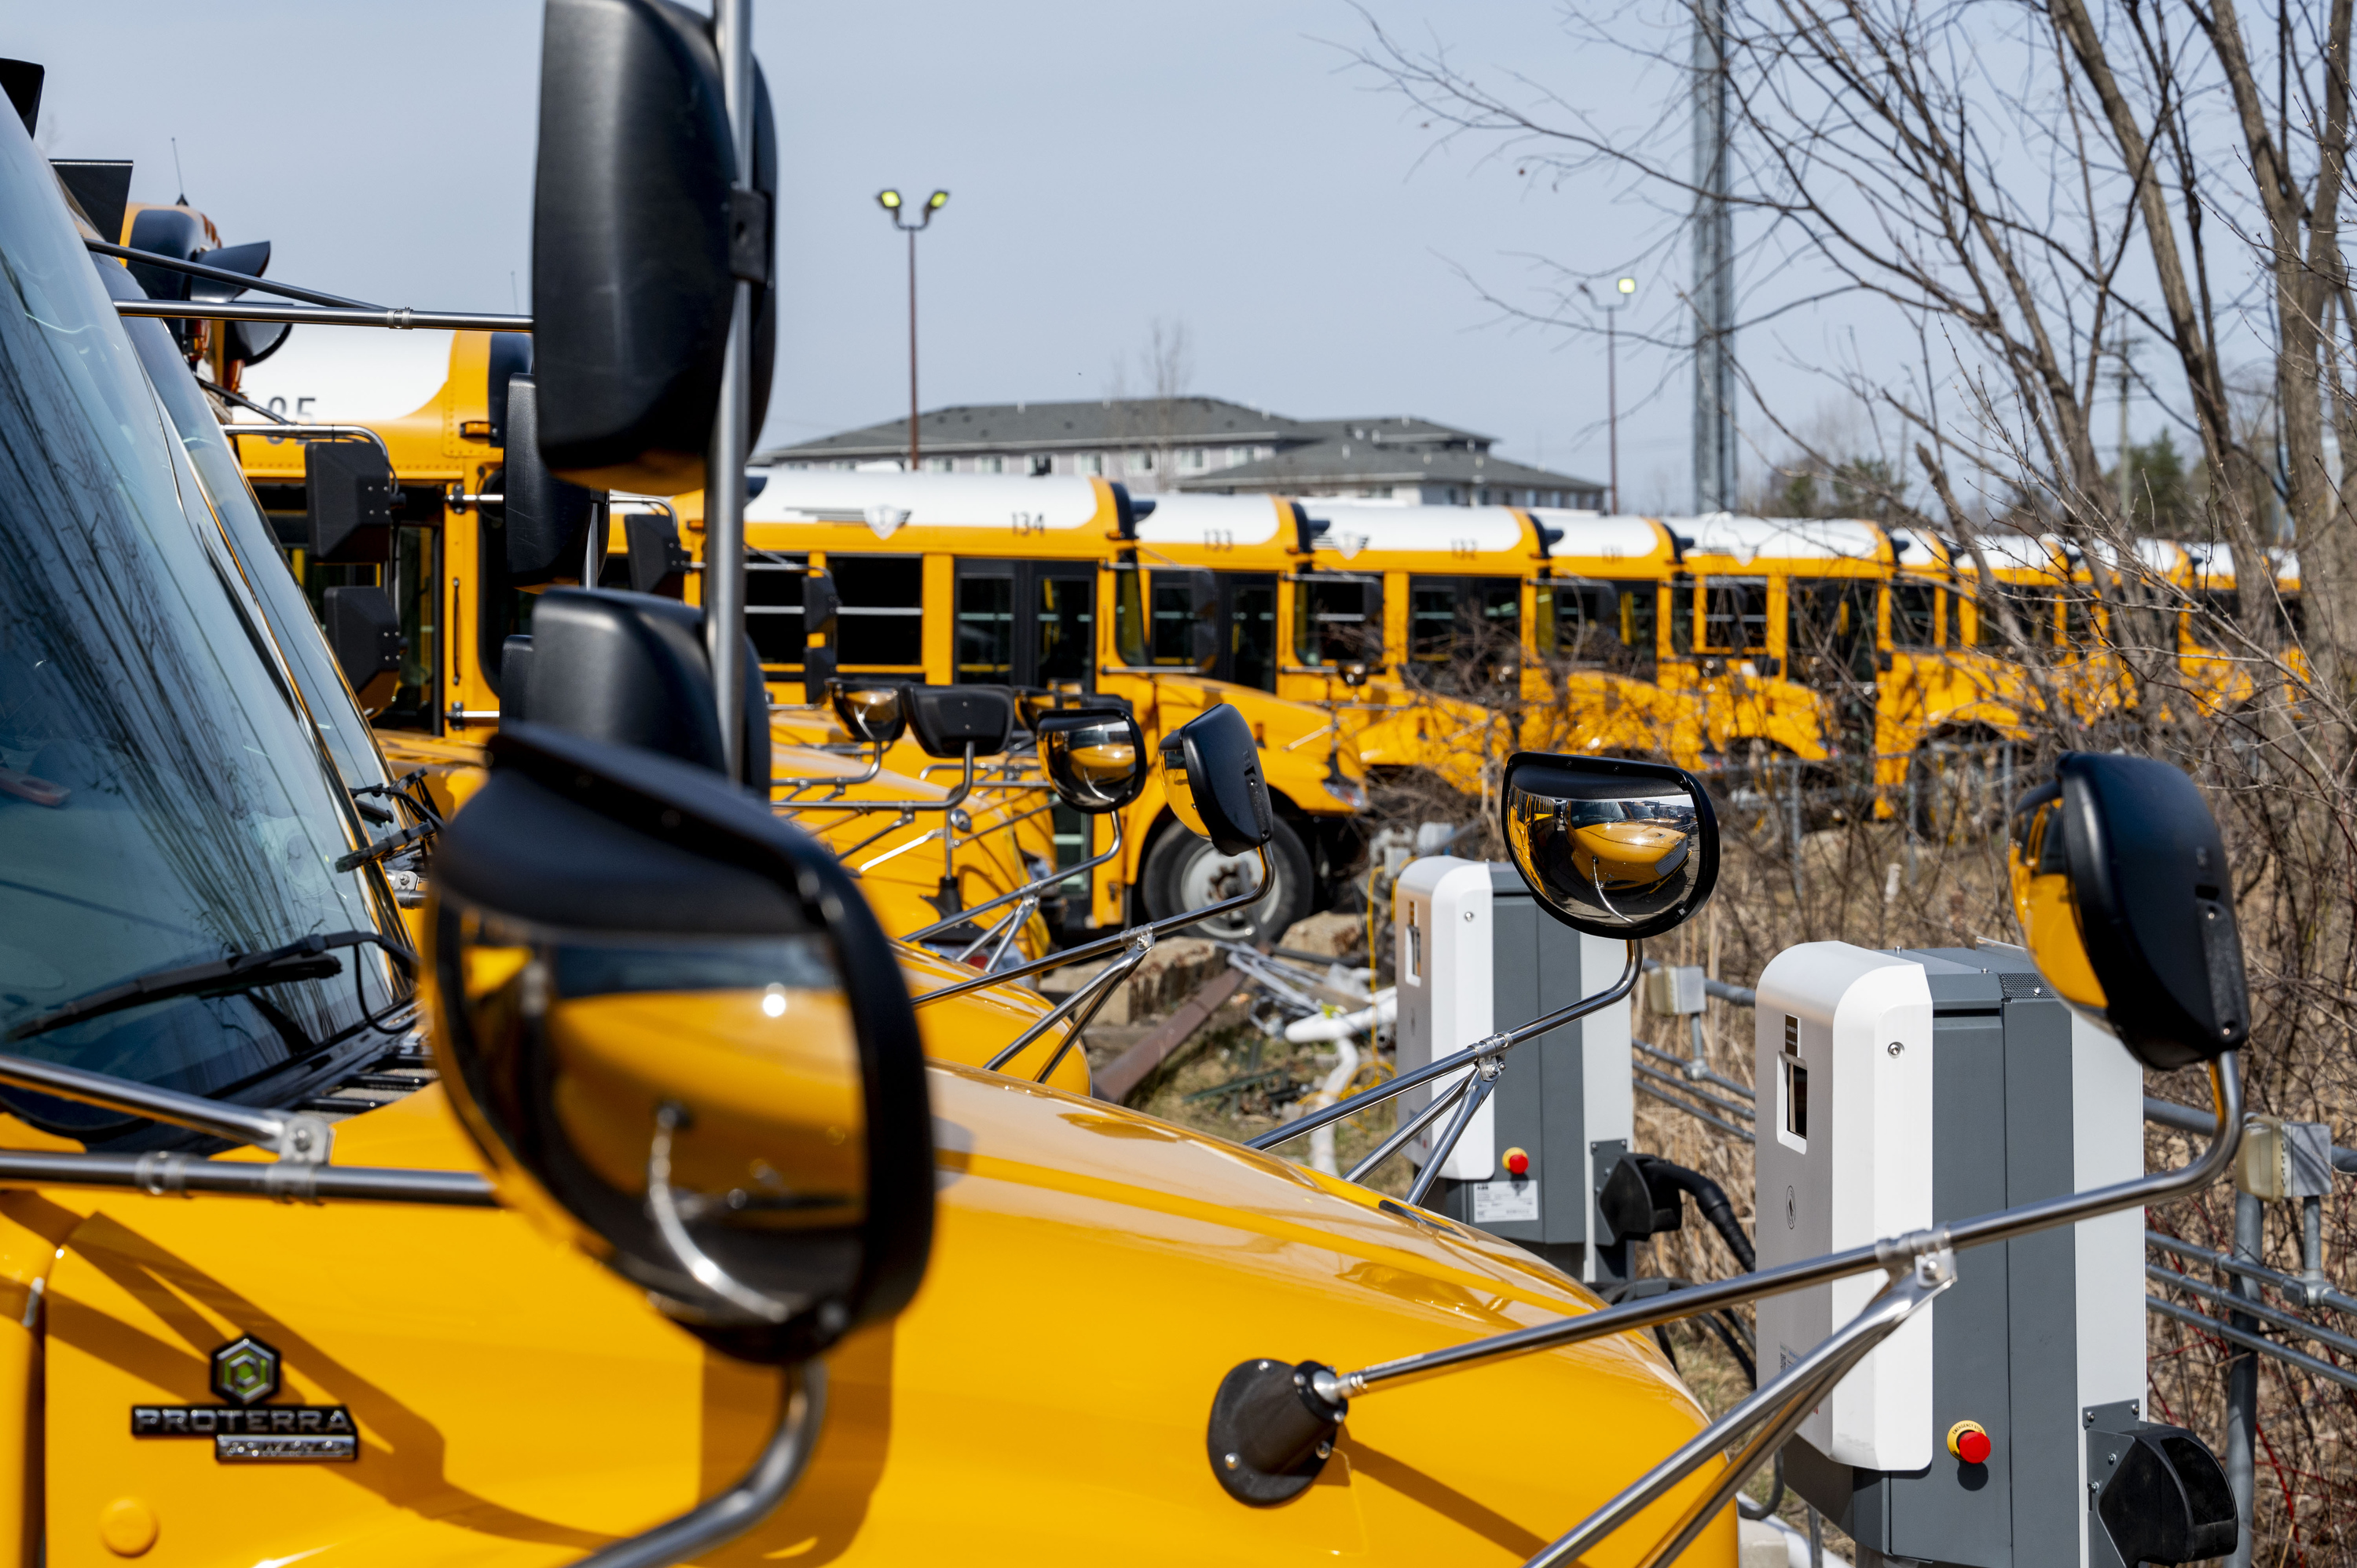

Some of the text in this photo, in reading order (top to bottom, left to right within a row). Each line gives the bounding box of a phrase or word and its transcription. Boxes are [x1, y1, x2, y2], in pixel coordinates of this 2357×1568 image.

[1011, 511, 1045, 537] 134
[1204, 528, 1234, 553] 133
[135, 1409, 352, 1433] PROTERRA
[1952, 1423, 1974, 1435] EMERGENCY
